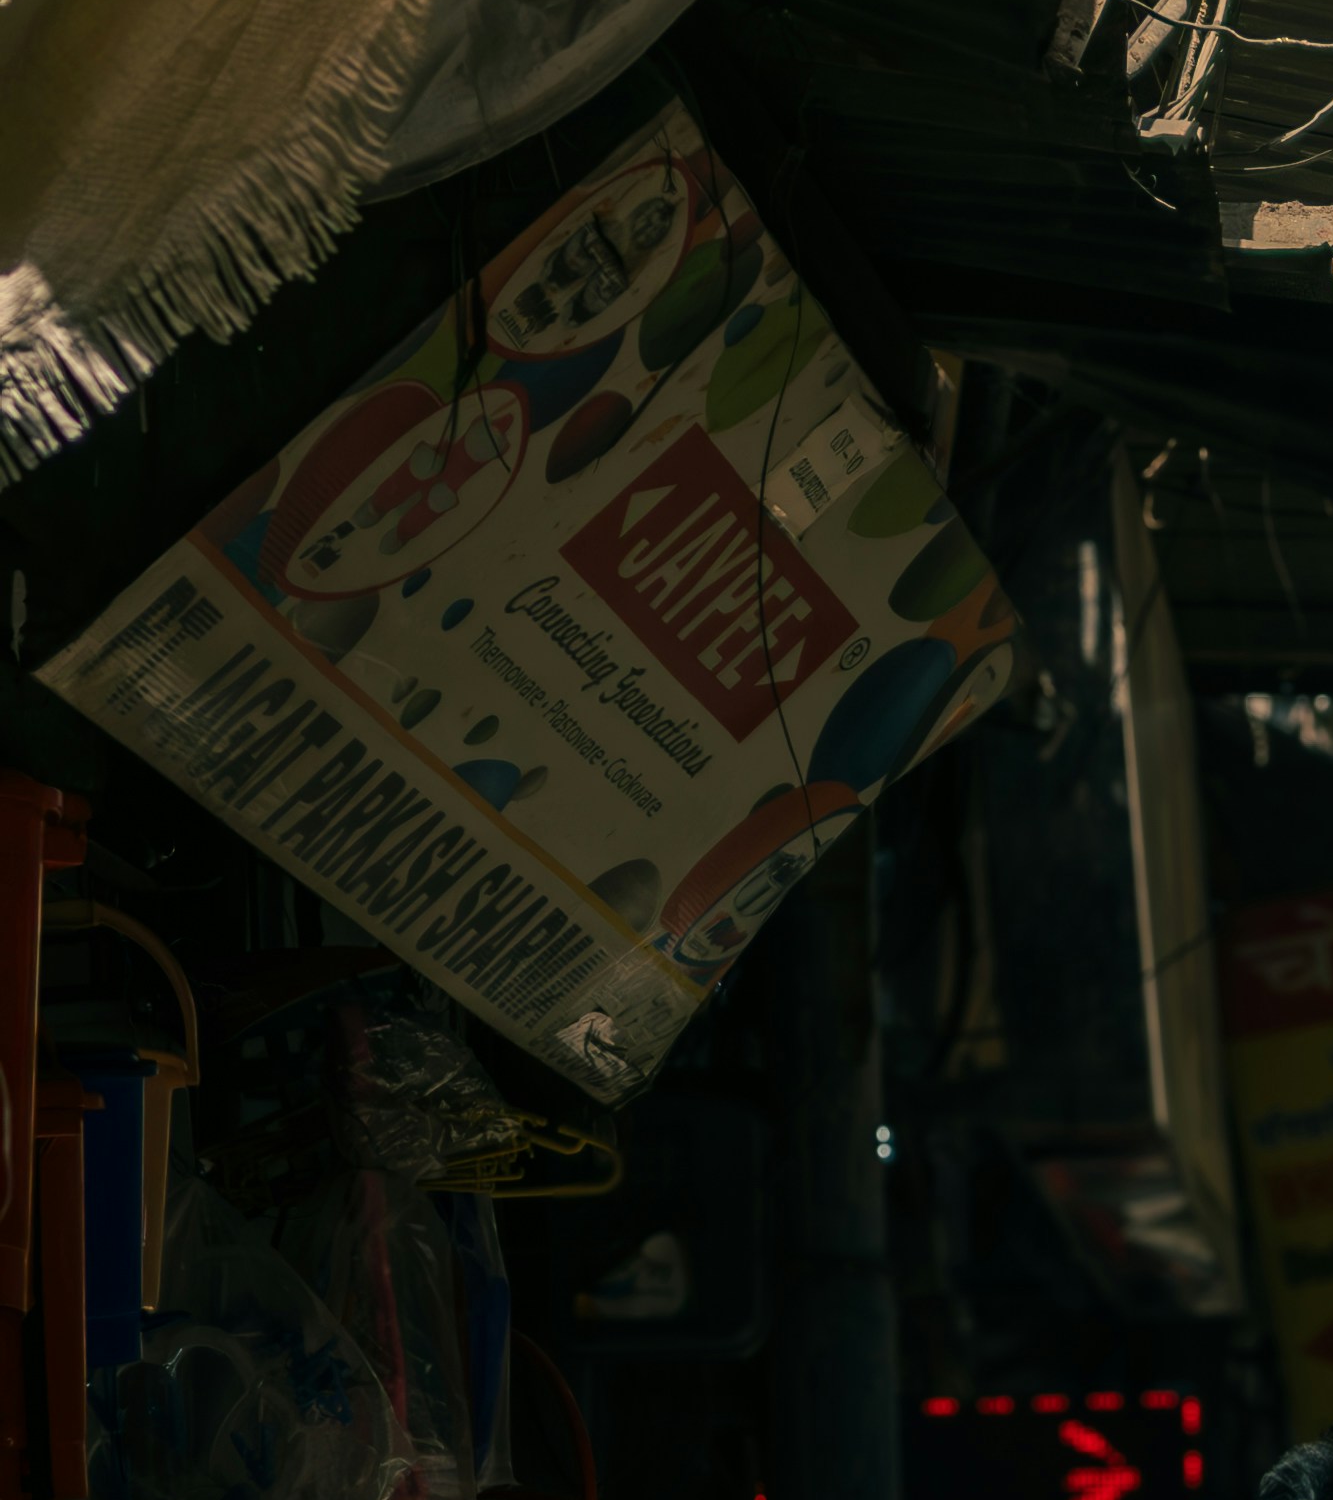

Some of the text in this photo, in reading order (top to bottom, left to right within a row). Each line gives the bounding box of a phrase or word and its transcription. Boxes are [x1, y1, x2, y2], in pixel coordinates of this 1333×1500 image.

[505, 566, 722, 780] Connecting Generations
[614, 487, 814, 695] JAYPEE
[468, 625, 667, 820] Thermoware Plastoware Cookware
[162, 642, 342, 813] JAGAT
[265, 738, 474, 936] PARKASH
[416, 852, 609, 1030] SHARMA
